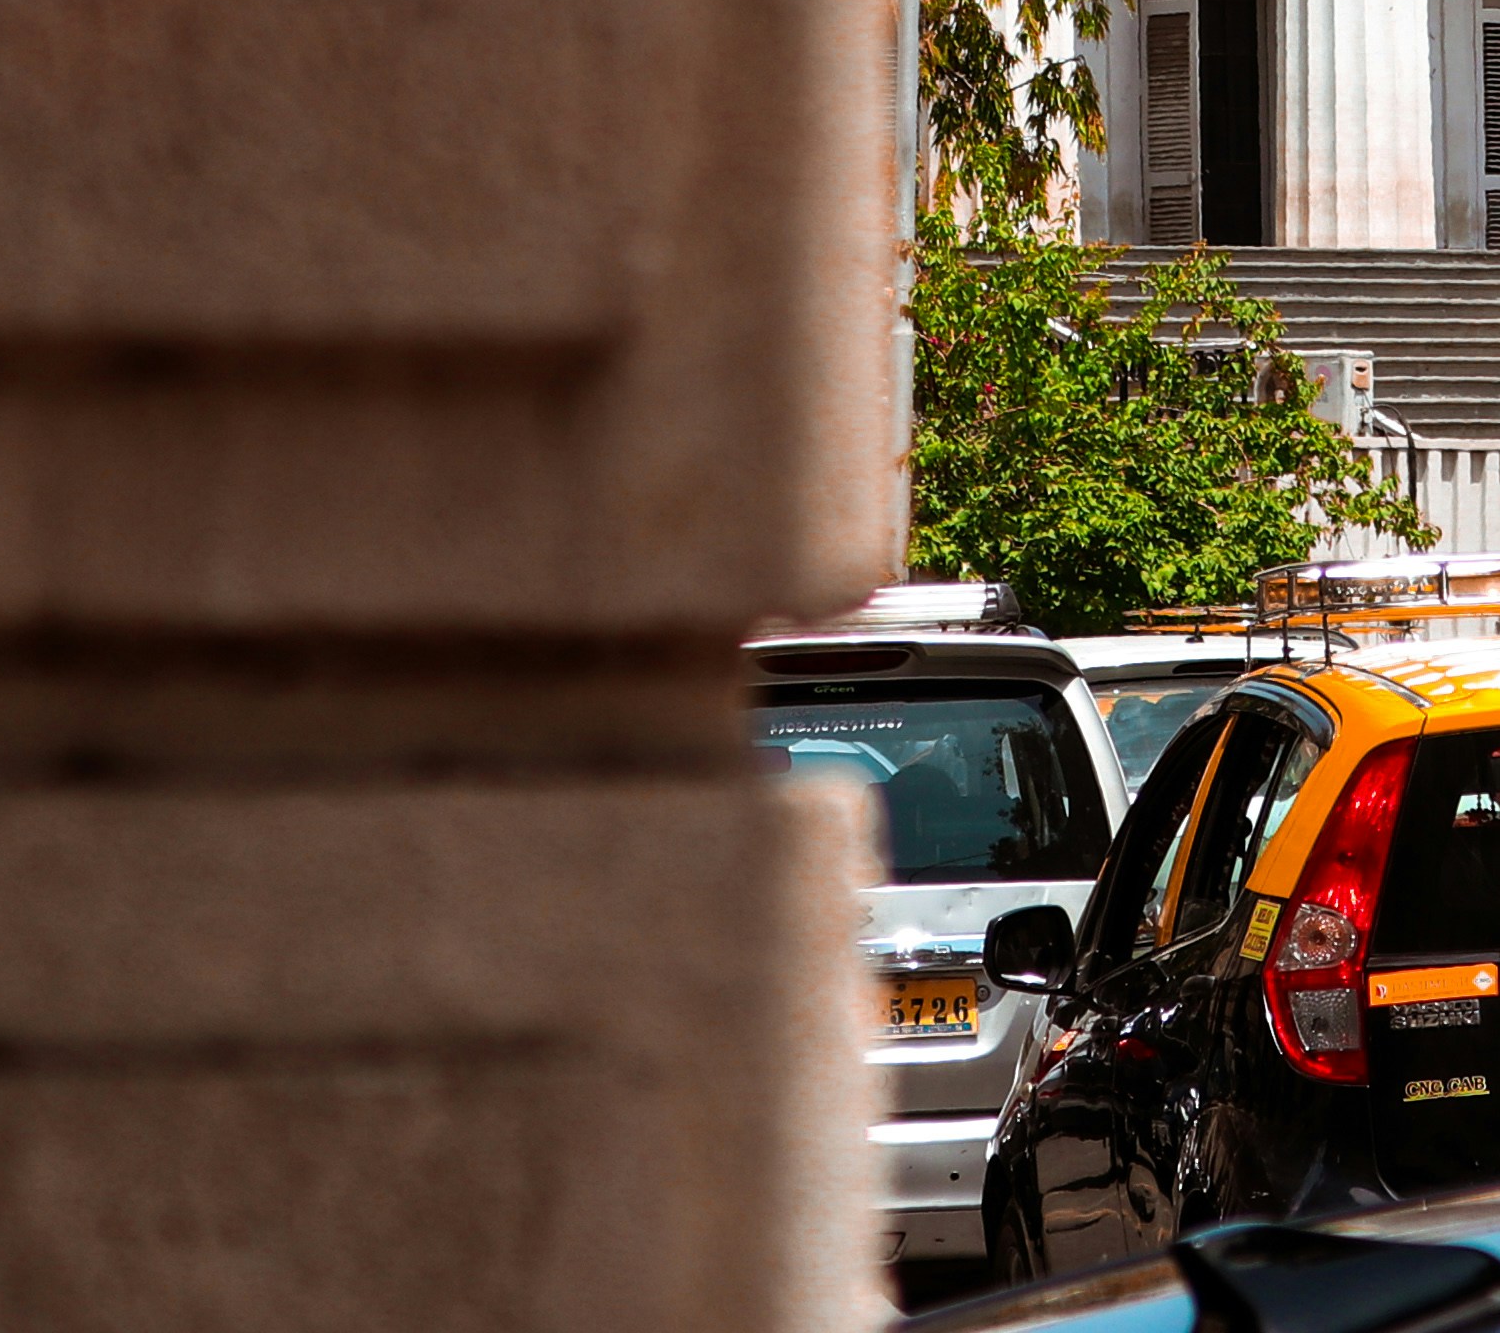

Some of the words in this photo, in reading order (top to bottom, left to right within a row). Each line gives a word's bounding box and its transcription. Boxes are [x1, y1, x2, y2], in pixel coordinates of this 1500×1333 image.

[813, 685, 856, 694] Green
[889, 995, 968, 1026] 5726
[1390, 1010, 1480, 1030] SUZUKI
[1405, 1079, 1445, 1098] CNG
[1446, 1076, 1487, 1094] CAB
